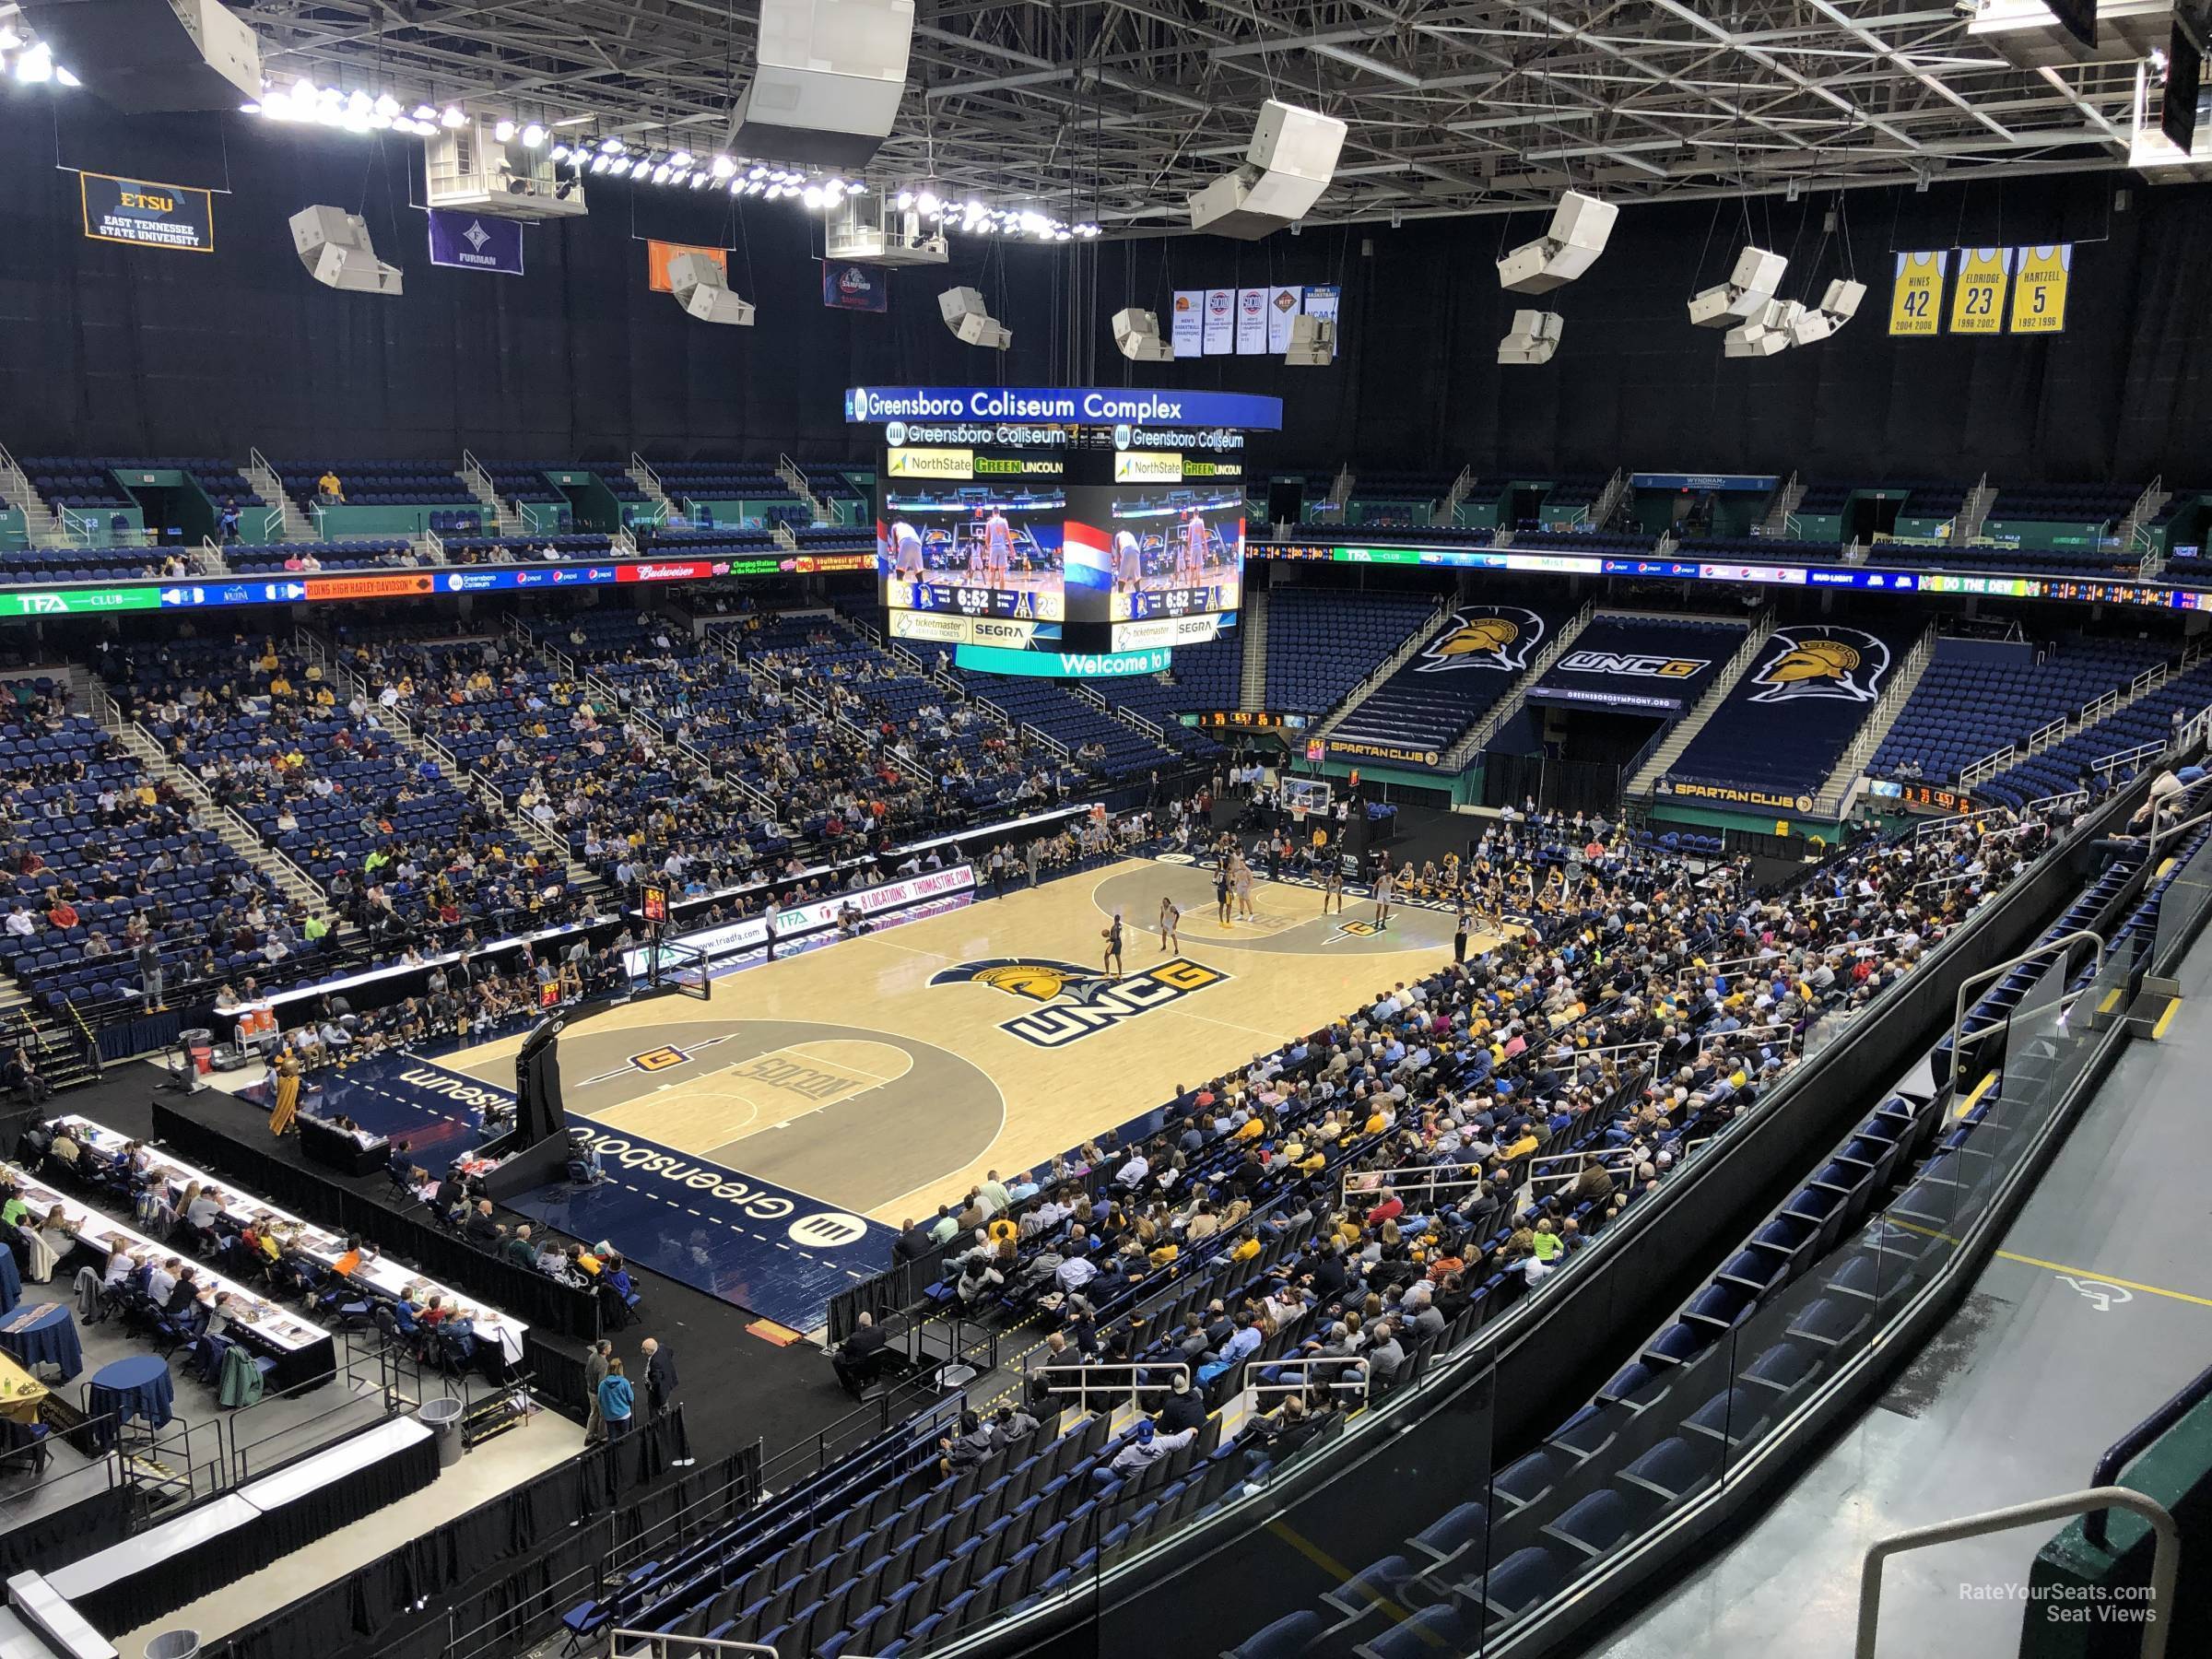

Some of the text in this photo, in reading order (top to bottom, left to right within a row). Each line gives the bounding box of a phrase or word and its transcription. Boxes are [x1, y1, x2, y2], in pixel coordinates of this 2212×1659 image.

[121, 192, 173, 212] ETSU
[104, 215, 194, 235] EAST TENNESSEE
[100, 226, 200, 246] STATE UNIVERSITY
[459, 253, 497, 265] FURMAN
[1908, 276, 1930, 287] HINES
[1966, 273, 2000, 284] ELDRIDGE
[2024, 271, 2061, 283] HARTZELL
[1904, 290, 1930, 317] 42
[1966, 288, 1993, 314] 23
[2033, 286, 2046, 313] 5
[1895, 321, 1912, 330] 2004
[1977, 319, 1994, 328] 2002
[2018, 317, 2036, 327] 1992
[869, 391, 1182, 424] Greensboro Coliseum Complex
[909, 426, 1065, 444] Greensboro Coliseum
[1133, 429, 1243, 449] Greensboro Coliseum
[912, 456, 971, 470] NorthState
[975, 457, 1064, 474] GREEN LINCOLN
[1135, 460, 1180, 474] NorthState
[1182, 460, 1241, 477] GREEN LINCOLN
[848, 556, 861, 564] grill
[1347, 549, 1371, 561] TFA
[637, 564, 694, 580] Budweiser
[733, 560, 756, 569] Charging
[464, 575, 497, 583] Greensboro
[527, 574, 542, 582] pepsi
[563, 572, 578, 582] pepsi
[598, 571, 612, 579] pepsi
[1813, 573, 1830, 582] BUD
[1830, 575, 1853, 583] LIGHT
[307, 582, 330, 595] RIDING
[332, 582, 348, 594] HIGH
[1943, 576, 1959, 590] DO
[1963, 579, 1985, 592] THE
[1988, 580, 2012, 594] DEW
[2042, 584, 2048, 593] 1
[2069, 586, 2077, 595] 2
[895, 584, 913, 605] 23
[957, 588, 989, 607] 6:52
[2096, 588, 2103, 598] 4
[2123, 590, 2134, 600] 14
[17, 594, 124, 613] TFA CLUB
[1117, 597, 1132, 617] 23
[1166, 592, 1189, 608] 6:52
[915, 618, 962, 630] ticketmaster
[975, 623, 1024, 638] SEGRA
[1133, 626, 1170, 637] ticketmaster
[1179, 620, 1212, 634] SEGRA
[1060, 651, 1161, 675] Welcome to
[1563, 652, 1705, 678] UNCG
[1568, 691, 1670, 707] GREENSBOROSYMPHONY.ORG
[1331, 742, 1388, 758] SPARTAN
[1389, 750, 1423, 762] CLUB
[1675, 783, 1794, 808] SPARTAN CLUB
[1341, 853, 1359, 865] TFA
[861, 896, 868, 910] 8
[869, 886, 907, 909] LOCATIONS
[912, 868, 971, 895] THOMASTIRE.COM
[776, 911, 808, 930] TFA
[693, 928, 760, 952] www.triadfa.com
[1005, 959, 1226, 1046] UNCG
[731, 1057, 865, 1101] SOCON
